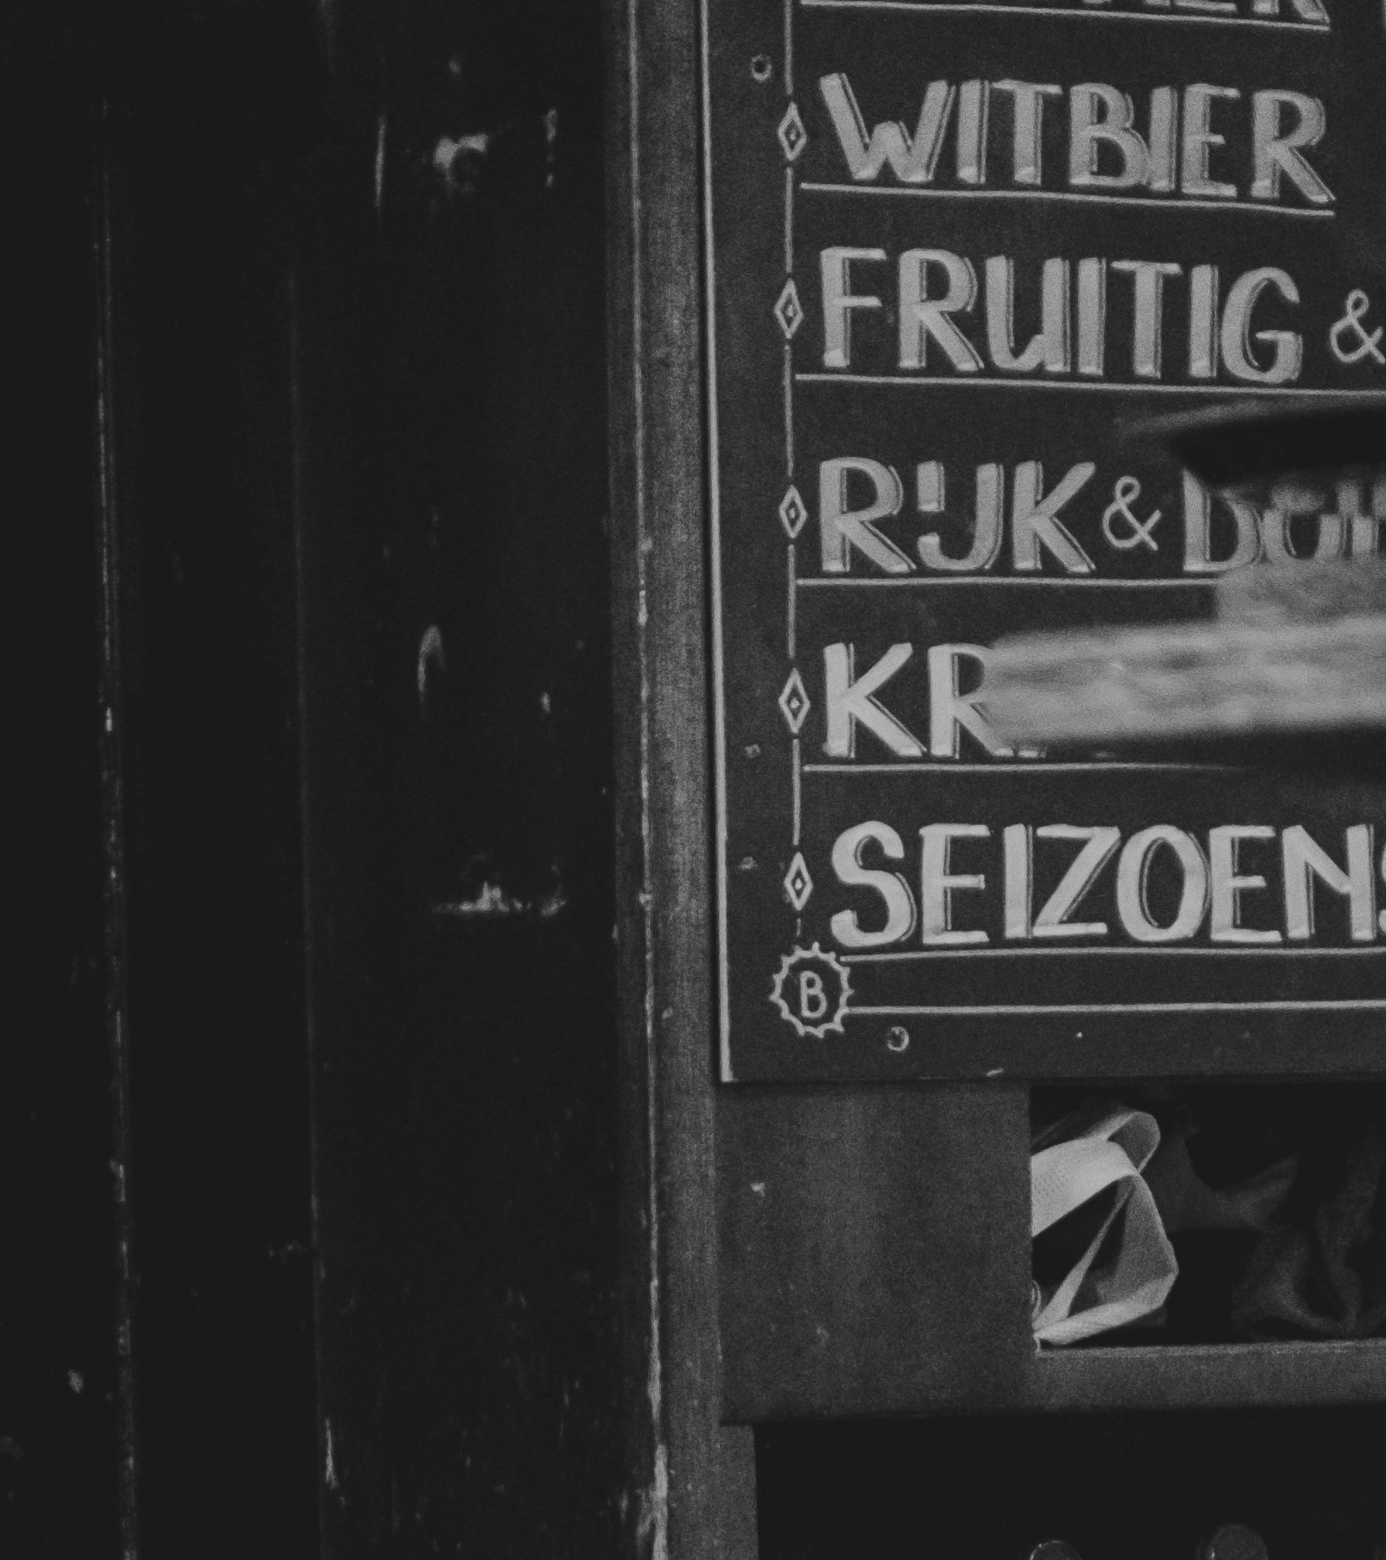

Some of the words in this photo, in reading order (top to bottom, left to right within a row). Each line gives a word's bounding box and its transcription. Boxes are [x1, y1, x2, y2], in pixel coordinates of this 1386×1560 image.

[819, 71, 1336, 203] WITBIER
[819, 246, 1302, 383] FRUITIG
[1329, 288, 1386, 364] &
[819, 455, 1096, 574] RIJK
[1101, 474, 1162, 551] &
[800, 970, 828, 1019] B
